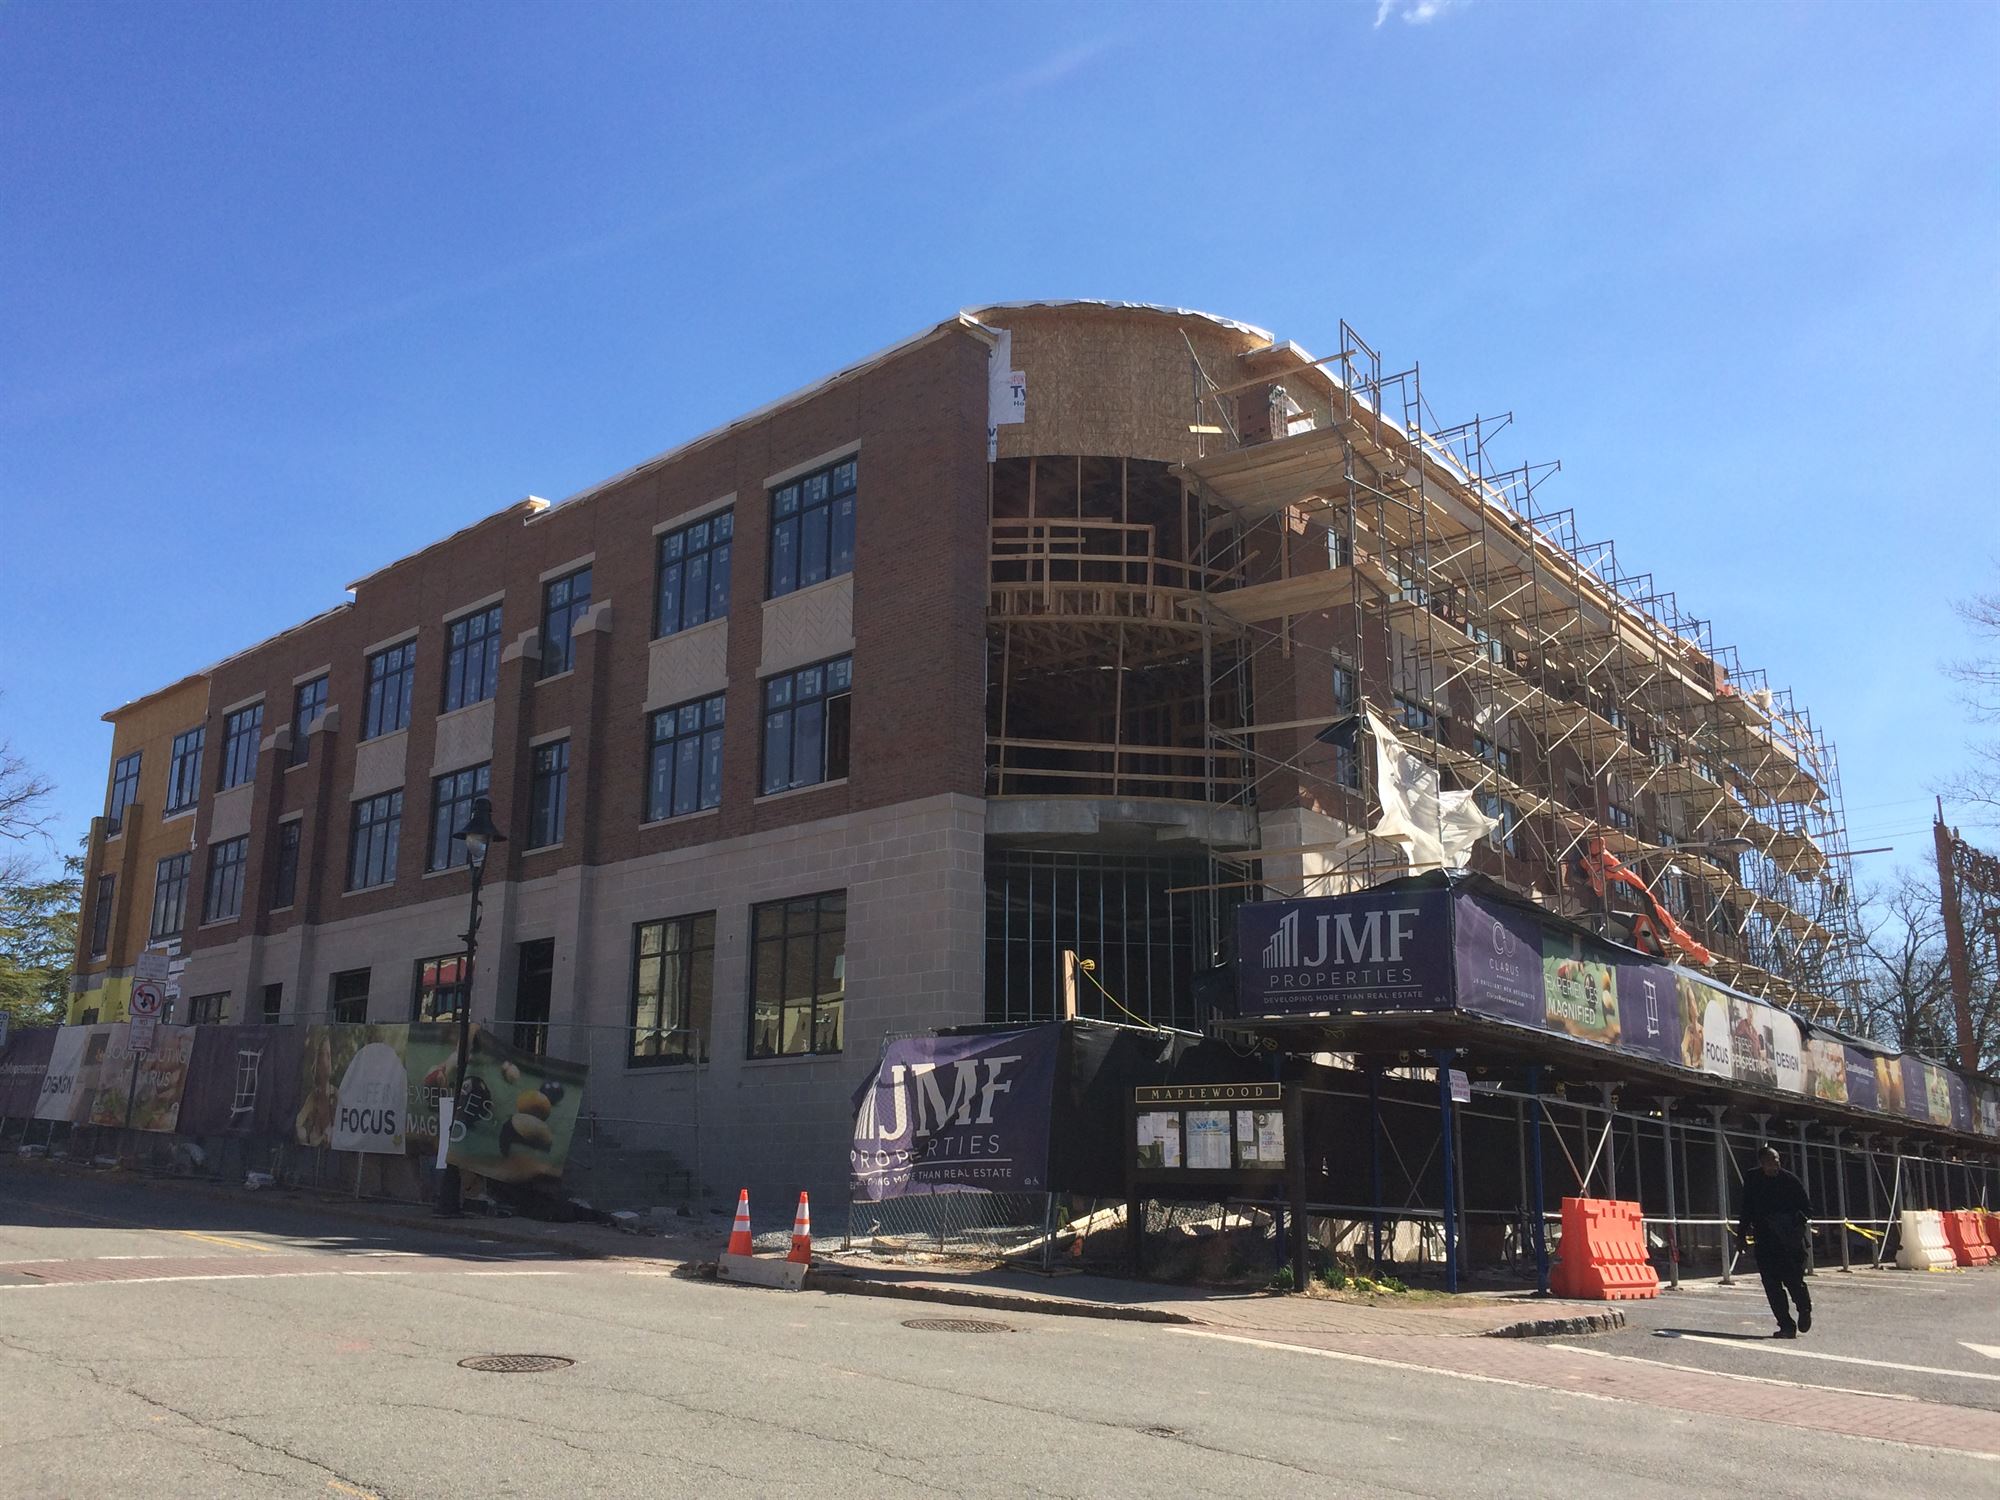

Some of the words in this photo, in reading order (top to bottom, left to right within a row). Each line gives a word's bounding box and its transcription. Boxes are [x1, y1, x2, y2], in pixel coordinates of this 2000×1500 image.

[1303, 908, 1420, 967] JMF
[1488, 957, 1520, 977] CLARUS
[1270, 968, 1412, 988] PROPERTIES
[1263, 994, 1314, 1004] DEVELOPING
[1392, 991, 1423, 999] ESTATE
[1547, 997, 1596, 1025] MAGNIFIED
[1706, 1041, 1729, 1065] FOCUS
[1775, 1051, 1799, 1072] DESIGN
[879, 1055, 1022, 1141] JMF
[1151, 1086, 1263, 1100] MAPLEWOOD
[340, 1107, 396, 1135] FOCUS
[918, 1170, 941, 1180] THAN
[944, 1169, 970, 1179] REAL
[973, 1168, 1012, 1178] ESTATE
